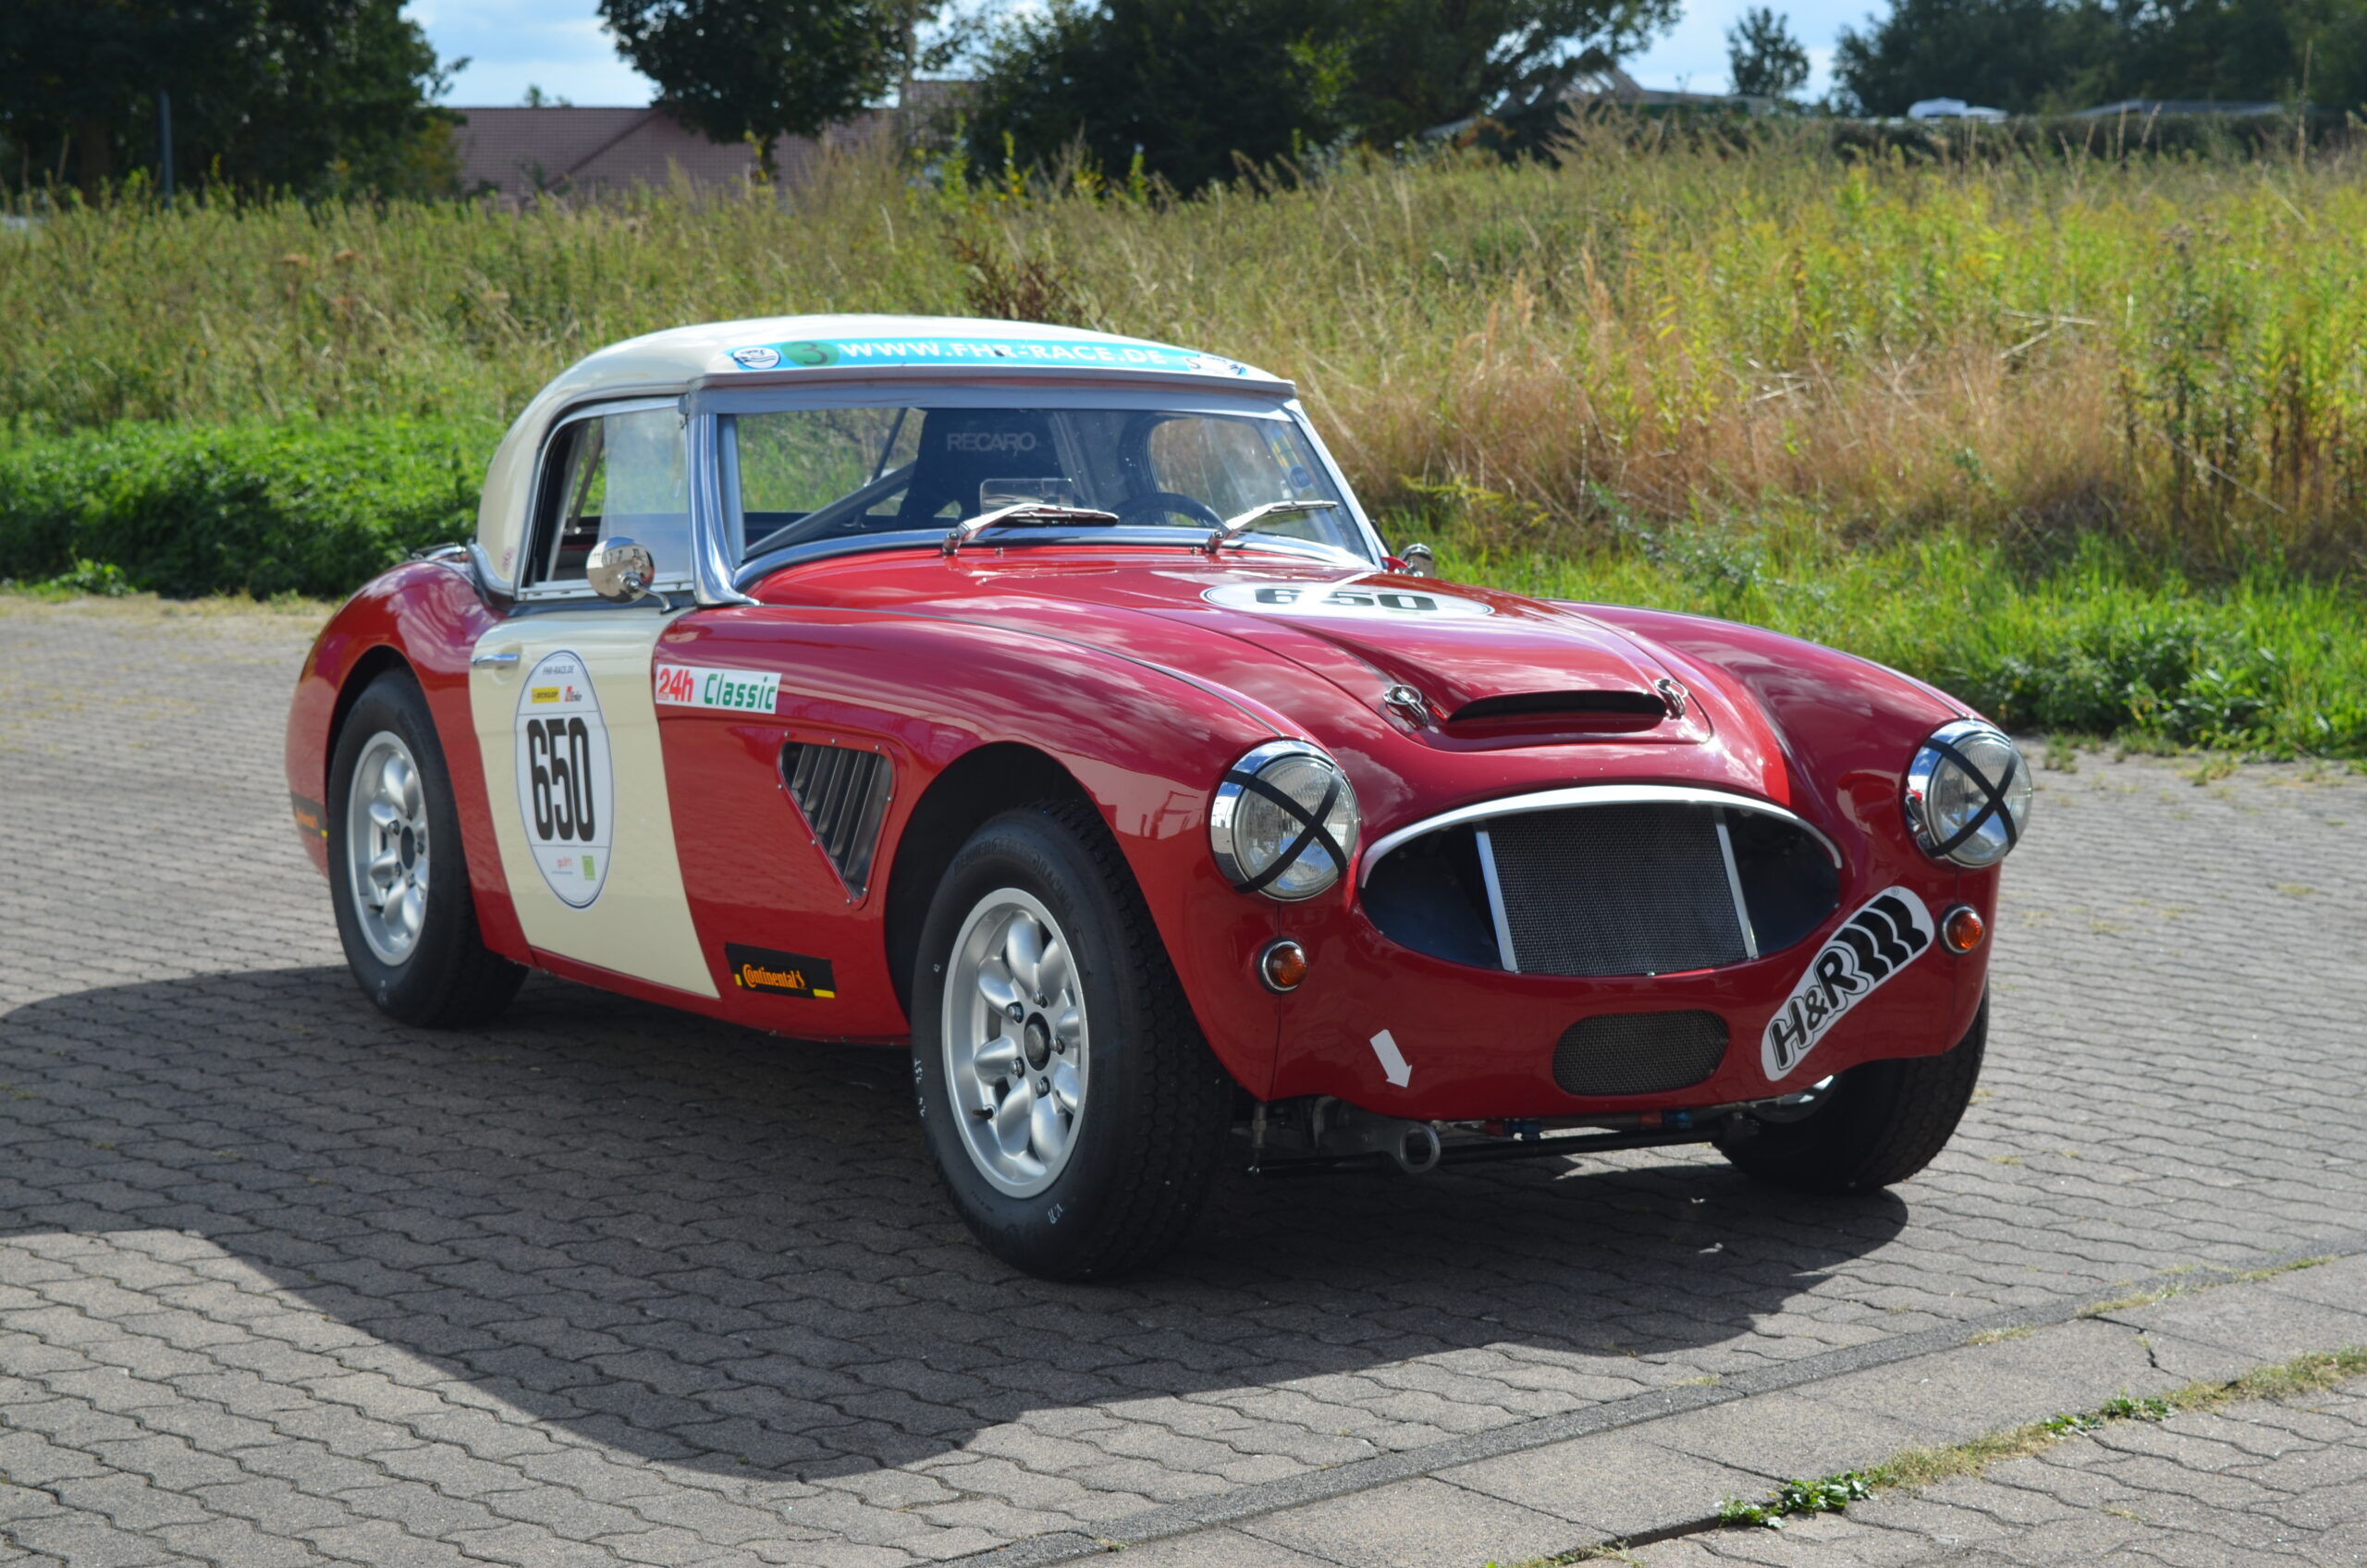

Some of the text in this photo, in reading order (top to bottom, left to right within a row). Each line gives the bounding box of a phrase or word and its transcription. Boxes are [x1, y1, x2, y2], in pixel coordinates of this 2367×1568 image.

[947, 432, 1036, 452] RECARO
[1255, 588, 1439, 611] 650
[658, 668, 777, 710] 24h Classic
[527, 717, 595, 842] 650
[742, 963, 799, 989] Continental
[1771, 950, 1858, 1067] H&R
